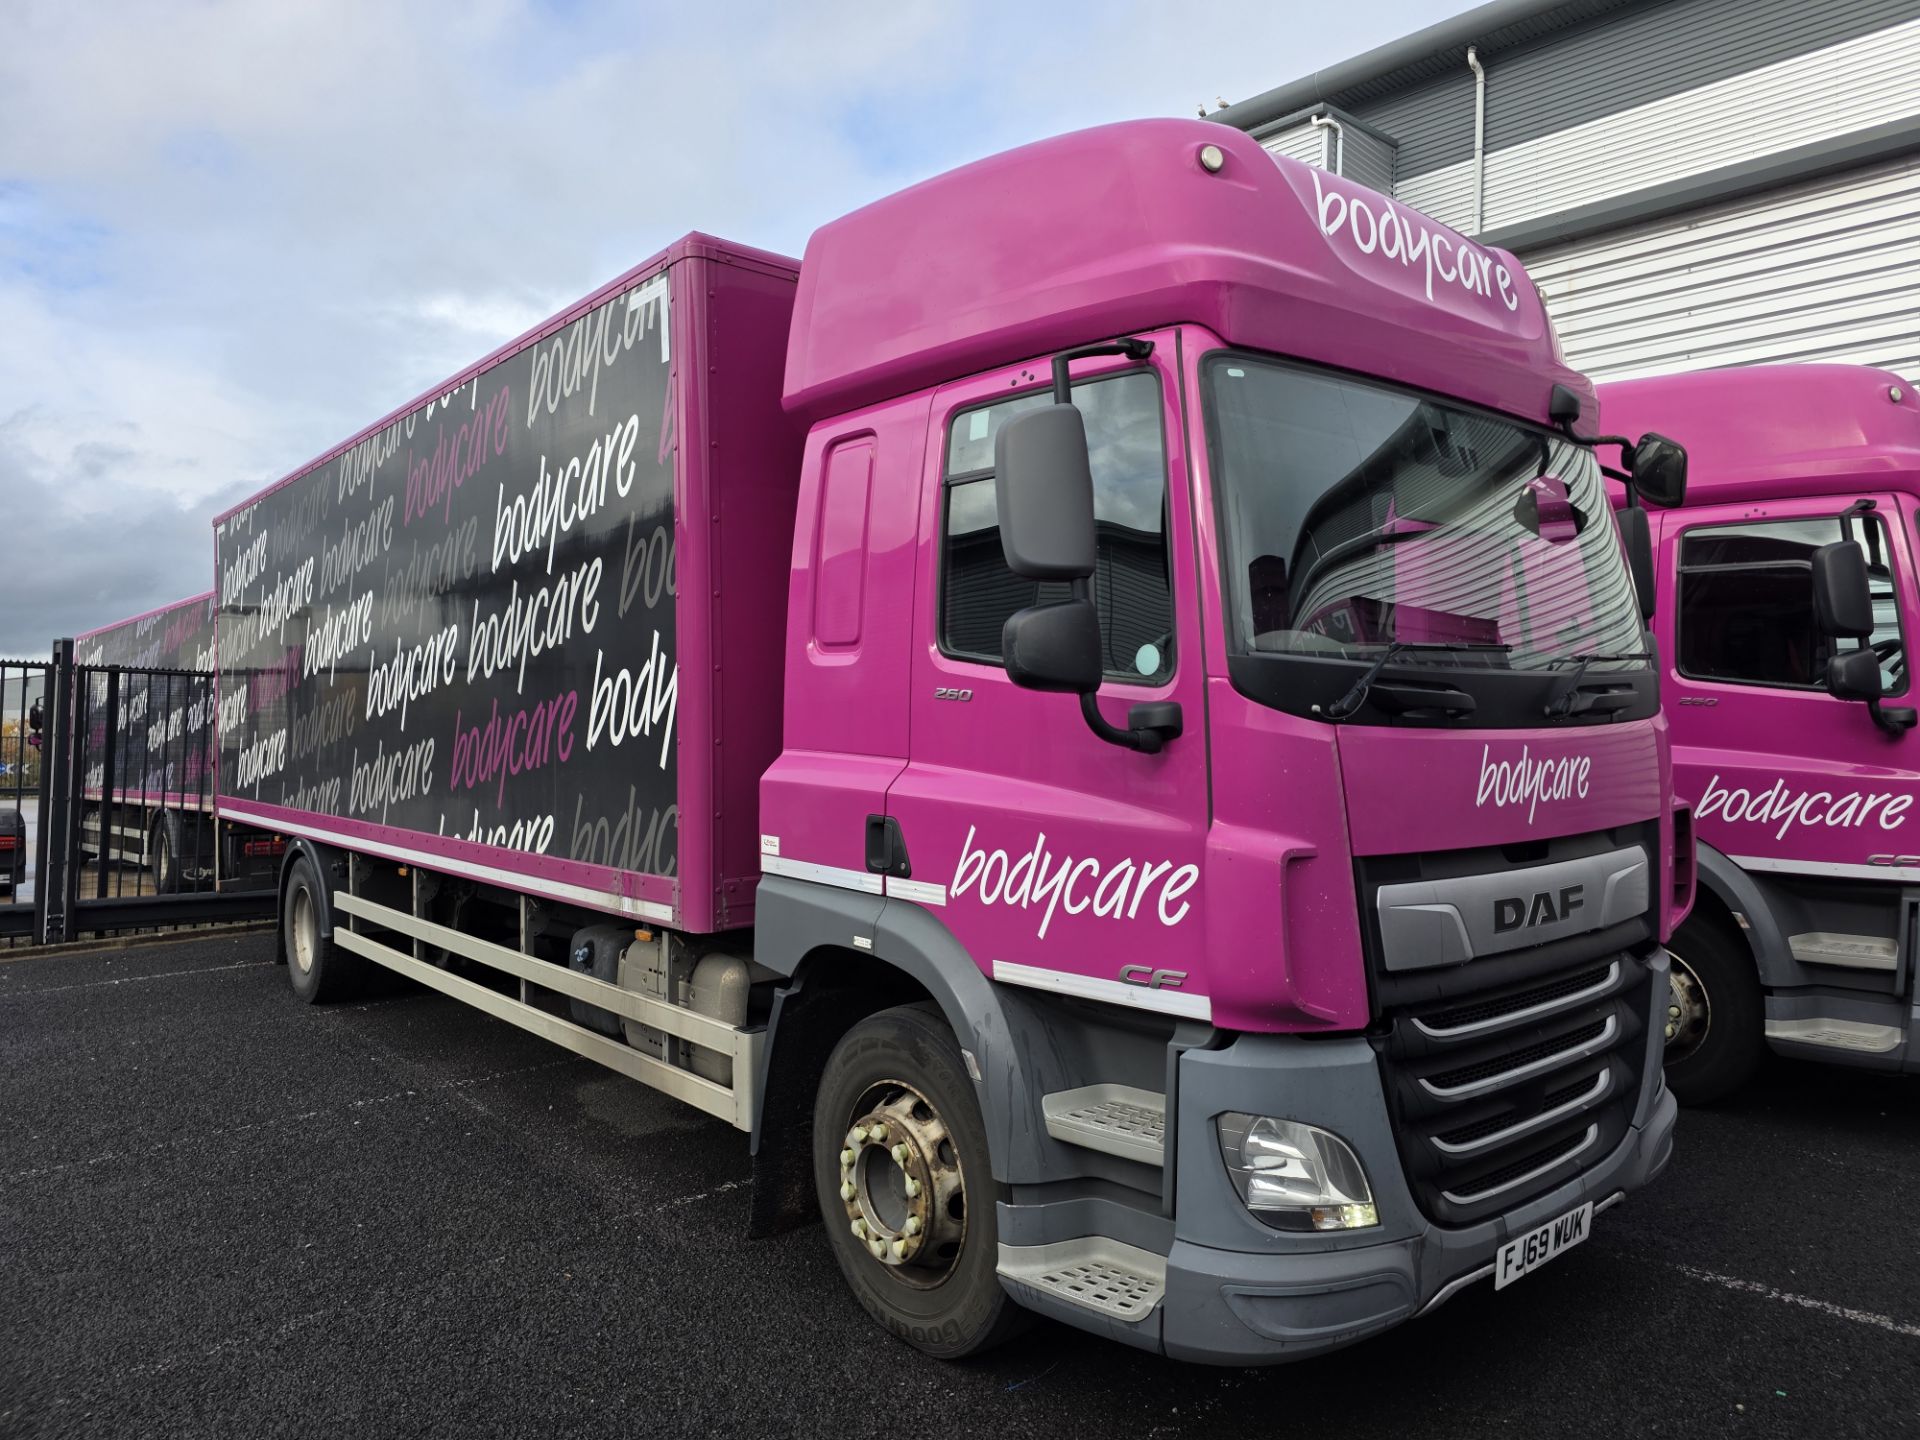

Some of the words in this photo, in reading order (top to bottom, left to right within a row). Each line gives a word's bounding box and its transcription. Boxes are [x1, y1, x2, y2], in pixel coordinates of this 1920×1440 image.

[1310, 169, 1518, 311] bodycare
[404, 385, 510, 529] bodycare
[492, 414, 639, 575] bodycare
[222, 529, 267, 612] bodycare
[320, 494, 394, 602] bodycare
[381, 515, 478, 635] bodycare
[259, 556, 314, 645] bodycare
[304, 590, 374, 686] bodycare
[467, 557, 603, 695] bodycare
[366, 624, 458, 732] bodycare
[934, 687, 973, 701] 260
[237, 727, 287, 801] bodycare
[291, 686, 357, 773] bodycare
[451, 690, 578, 810] bodycare
[350, 737, 435, 826] bodycare
[1475, 743, 1591, 824] bodycare
[1693, 774, 1914, 841] bodycare
[950, 824, 1199, 941] bodycare
[1494, 883, 1584, 934] DAF
[1119, 964, 1188, 990] CF
[1503, 1228, 1550, 1280] FJ69
[1553, 1207, 1586, 1251] WUK
